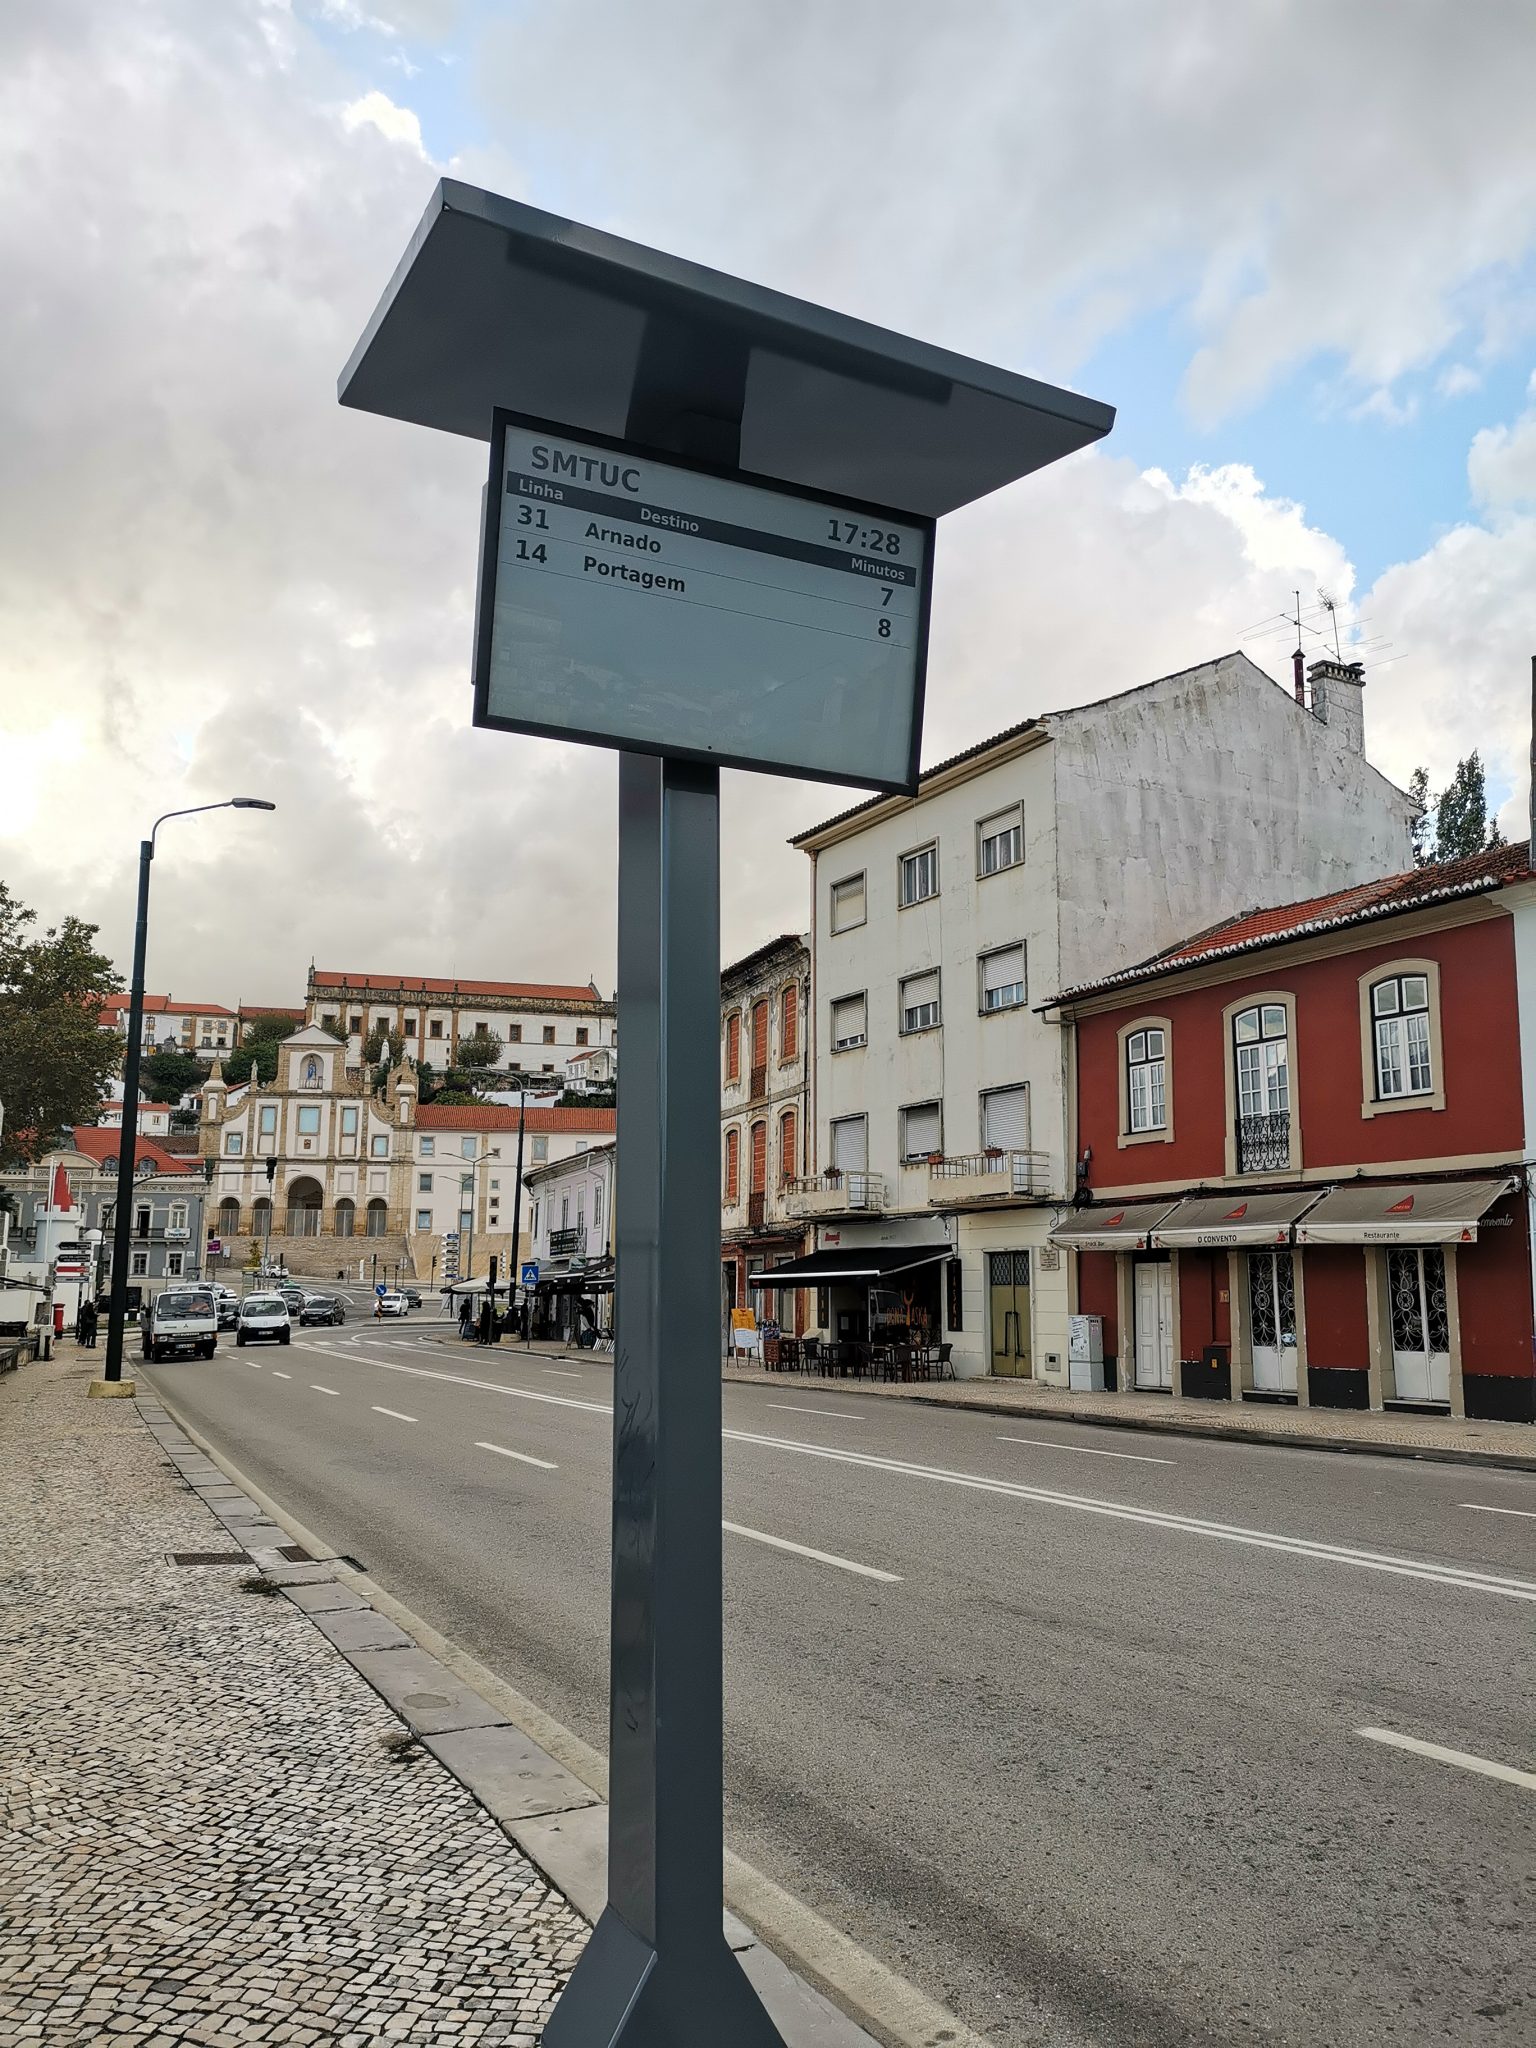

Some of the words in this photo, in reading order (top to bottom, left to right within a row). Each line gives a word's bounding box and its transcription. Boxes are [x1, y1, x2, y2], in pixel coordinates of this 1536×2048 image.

[519, 478, 564, 500] Linha
[640, 507, 700, 532] Destino
[851, 557, 905, 580] Minutos
[531, 446, 641, 492] SMTUC
[828, 520, 901, 556] 17:28
[515, 539, 548, 564] 14
[583, 555, 686, 592] Portagem
[878, 618, 891, 638] 8
[517, 504, 550, 530] 31
[585, 522, 662, 553] Arnado
[881, 587, 894, 606] 7
[1203, 1234, 1237, 1243] CONVENTO
[1363, 1231, 1400, 1239] Restaurante
